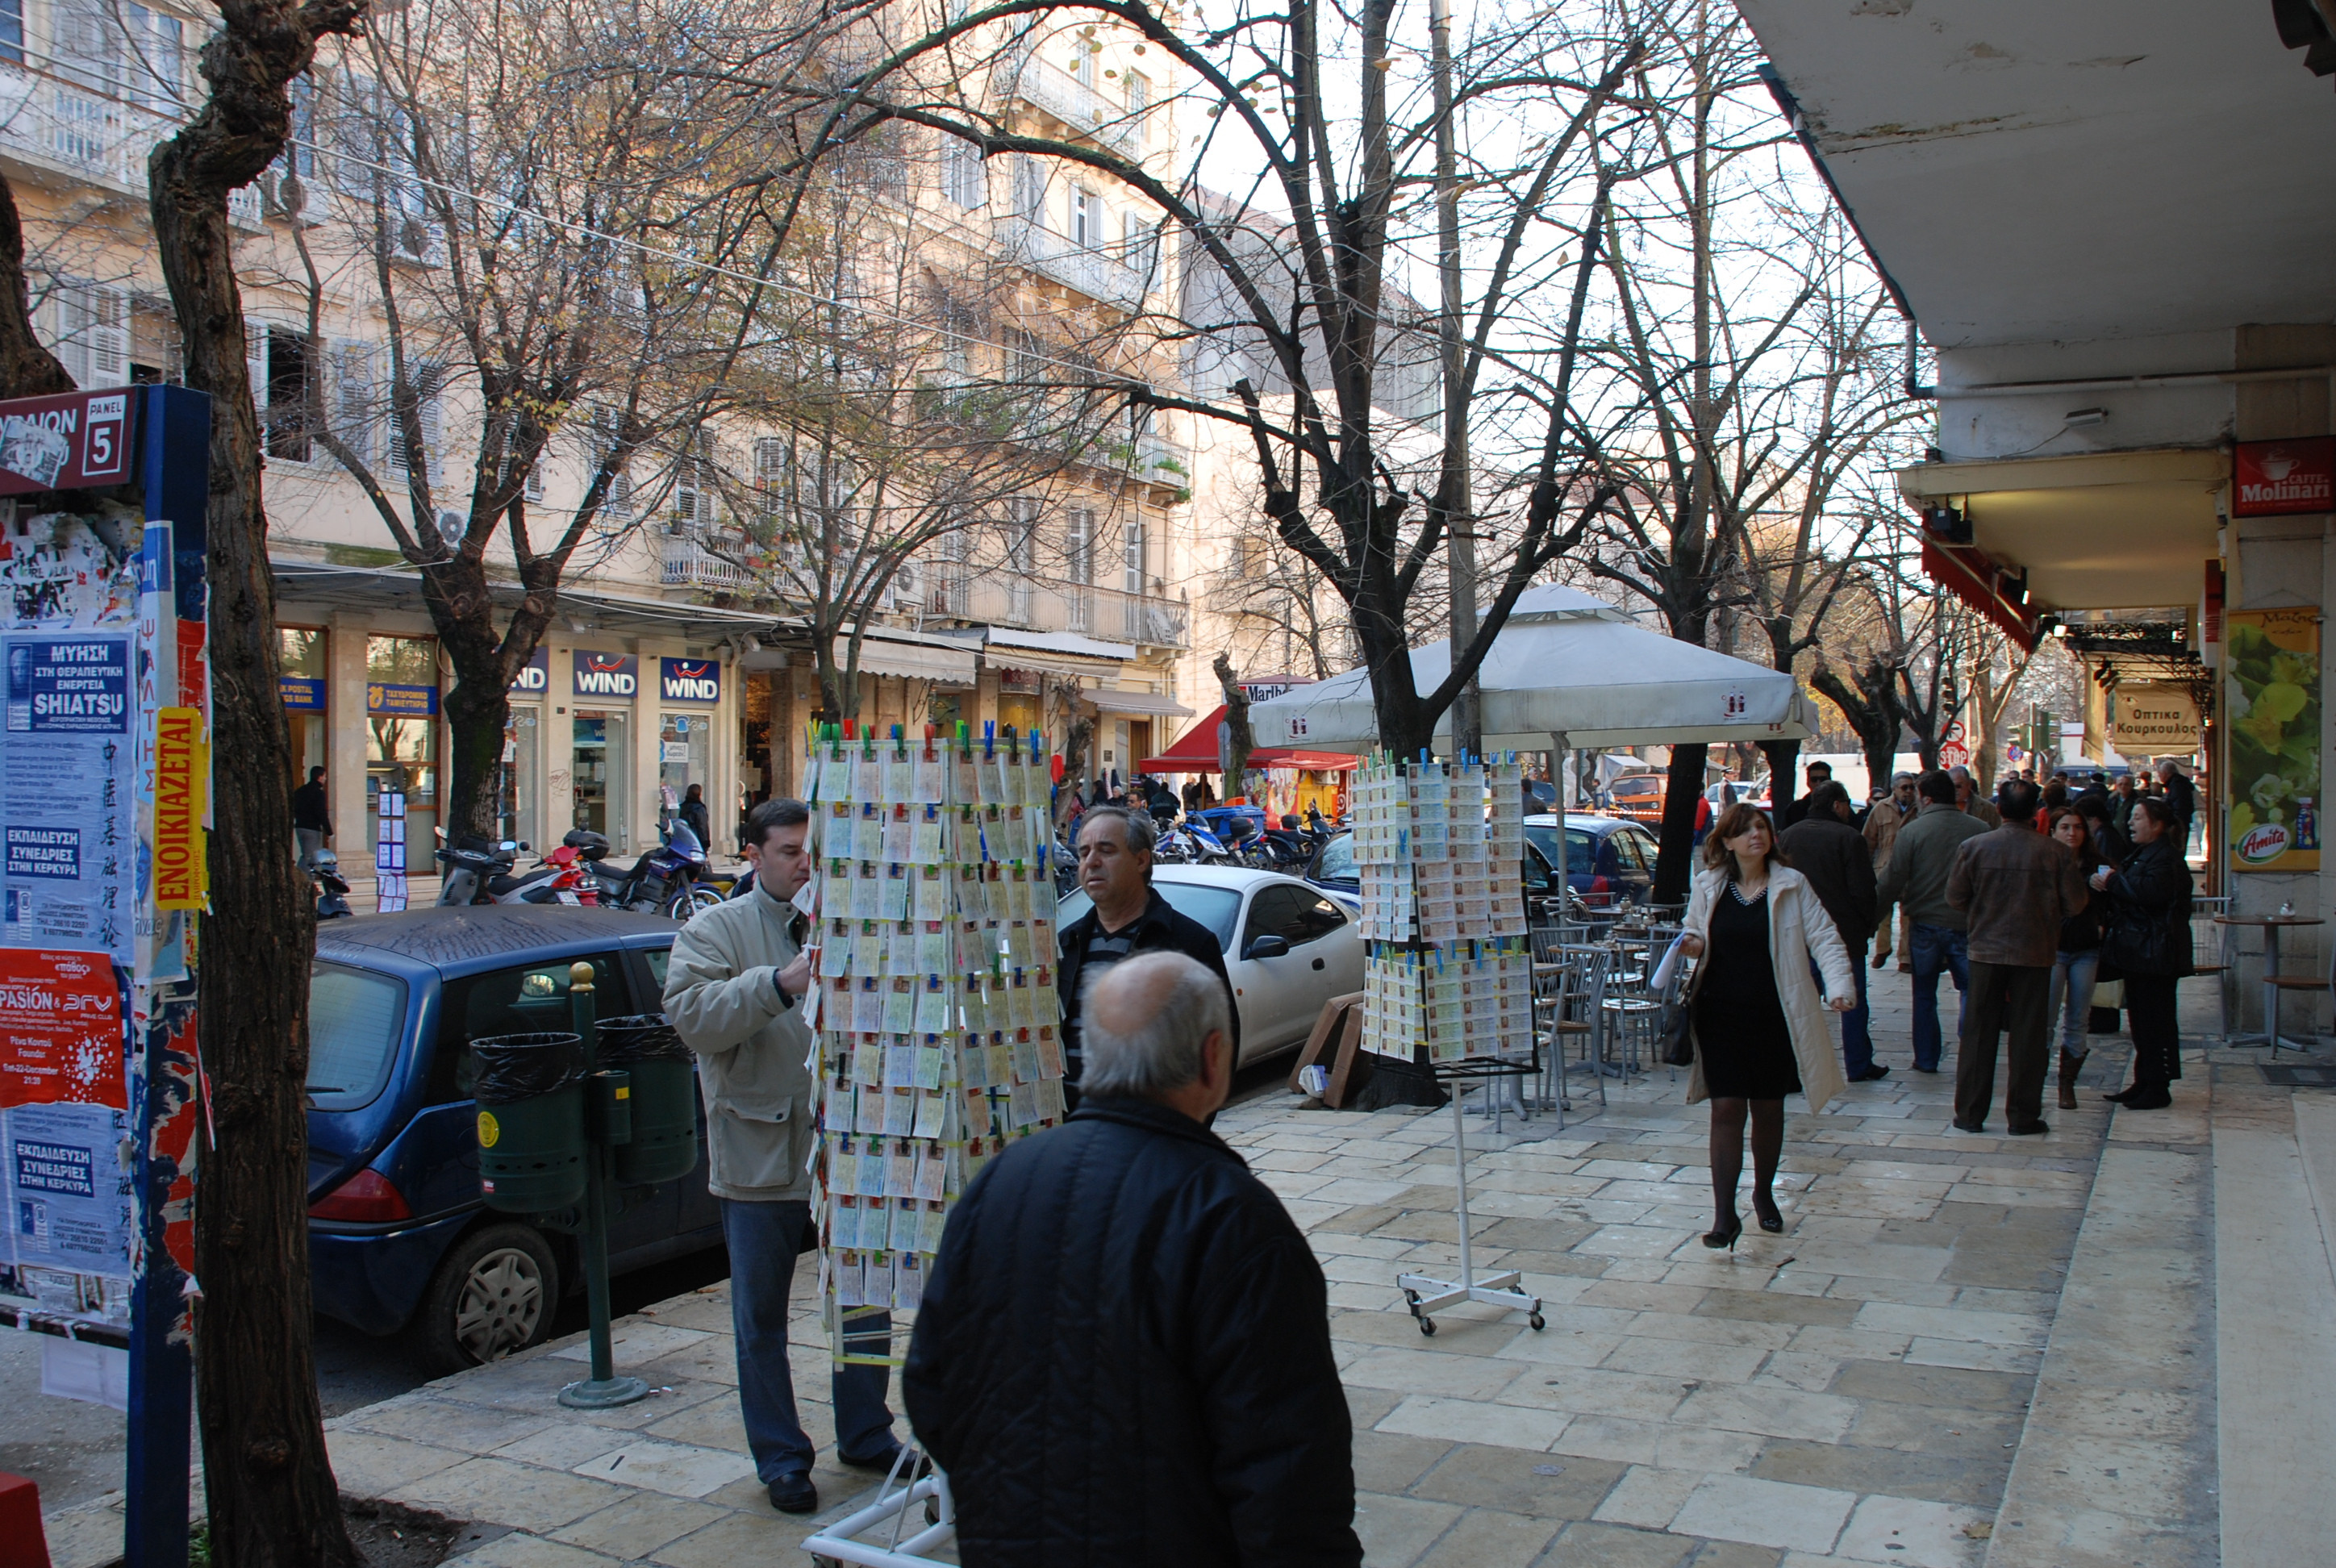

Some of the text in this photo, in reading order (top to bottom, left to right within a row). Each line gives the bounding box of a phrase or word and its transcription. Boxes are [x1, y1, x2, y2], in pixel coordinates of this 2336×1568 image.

[90, 402, 122, 415] PANEL
[92, 427, 112, 464] 5
[2241, 481, 2330, 503] Molinari
[51, 645, 109, 662] ΜΥΗΣΗ
[35, 666, 123, 678] ΣΤΗ ΘΕΡΑΠΕΥΤΙΚΗ
[511, 667, 546, 690] ND
[56, 680, 105, 690] ΕΝΕΡΓΕΙΑ
[288, 685, 314, 694] POSTAL
[577, 670, 636, 694] WIND
[664, 677, 718, 699] WIND
[294, 694, 314, 703] BANK
[1248, 686, 1295, 702] Marlb
[34, 694, 123, 715] SHIATSU
[2133, 709, 2180, 719] Οπτικα
[2117, 723, 2197, 736] Κουρκουλος
[1940, 750, 1967, 765] STOP
[157, 717, 191, 901] ΕΝΟΙΚΙΑΖΕΤΑΙ
[7, 829, 78, 845] ΕΚΠΑΙΔΕΥΣΗ
[2243, 828, 2285, 857] Amita
[11, 846, 74, 862] ΣΥΝΕΔΡΙΕΣ
[7, 861, 78, 875] ΣΤΗΝ ΚΕΡΚΥΡΑ
[17, 1143, 90, 1164] ΕΚΠΑΙΔΕΥΣΗ
[23, 1160, 87, 1179] ΣΥΝΕΔΡΙΕΣ
[20, 1174, 92, 1194] ΣΤΗΝ ΚΕΡΚΥΡΑ
